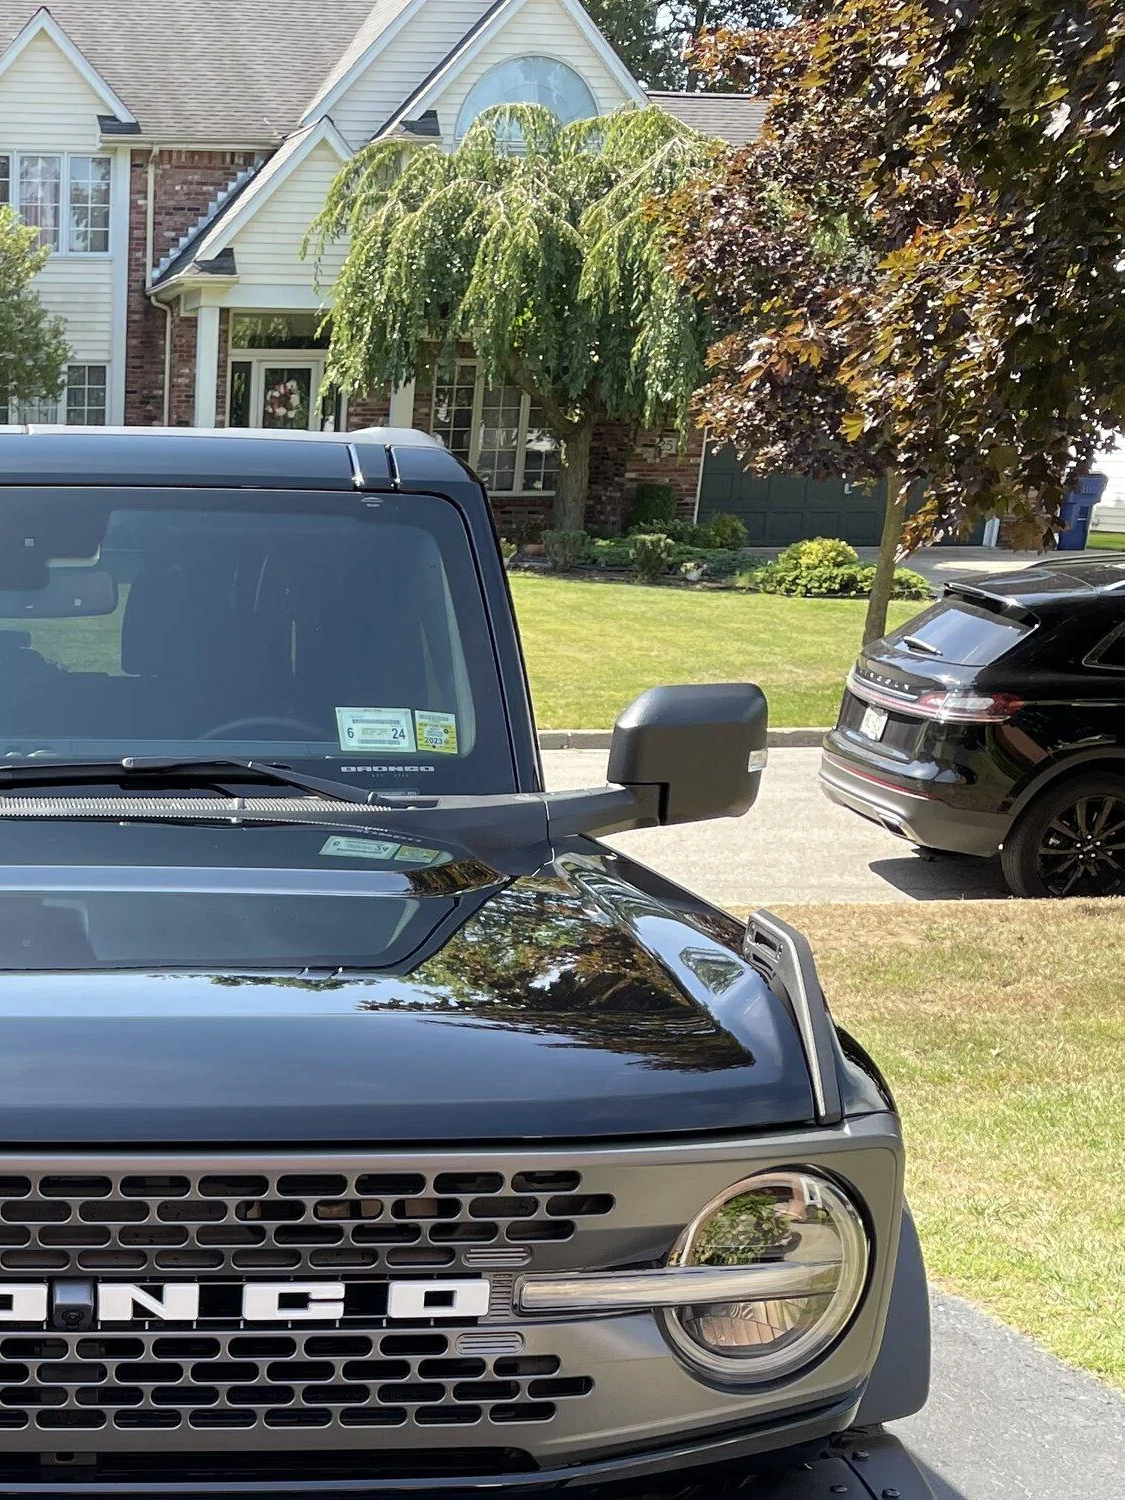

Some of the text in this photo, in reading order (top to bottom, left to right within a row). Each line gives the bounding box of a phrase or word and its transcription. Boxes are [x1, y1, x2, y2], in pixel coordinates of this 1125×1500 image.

[347, 727, 355, 739] 6
[391, 728, 406, 740] 24
[425, 736, 443, 745] 2023
